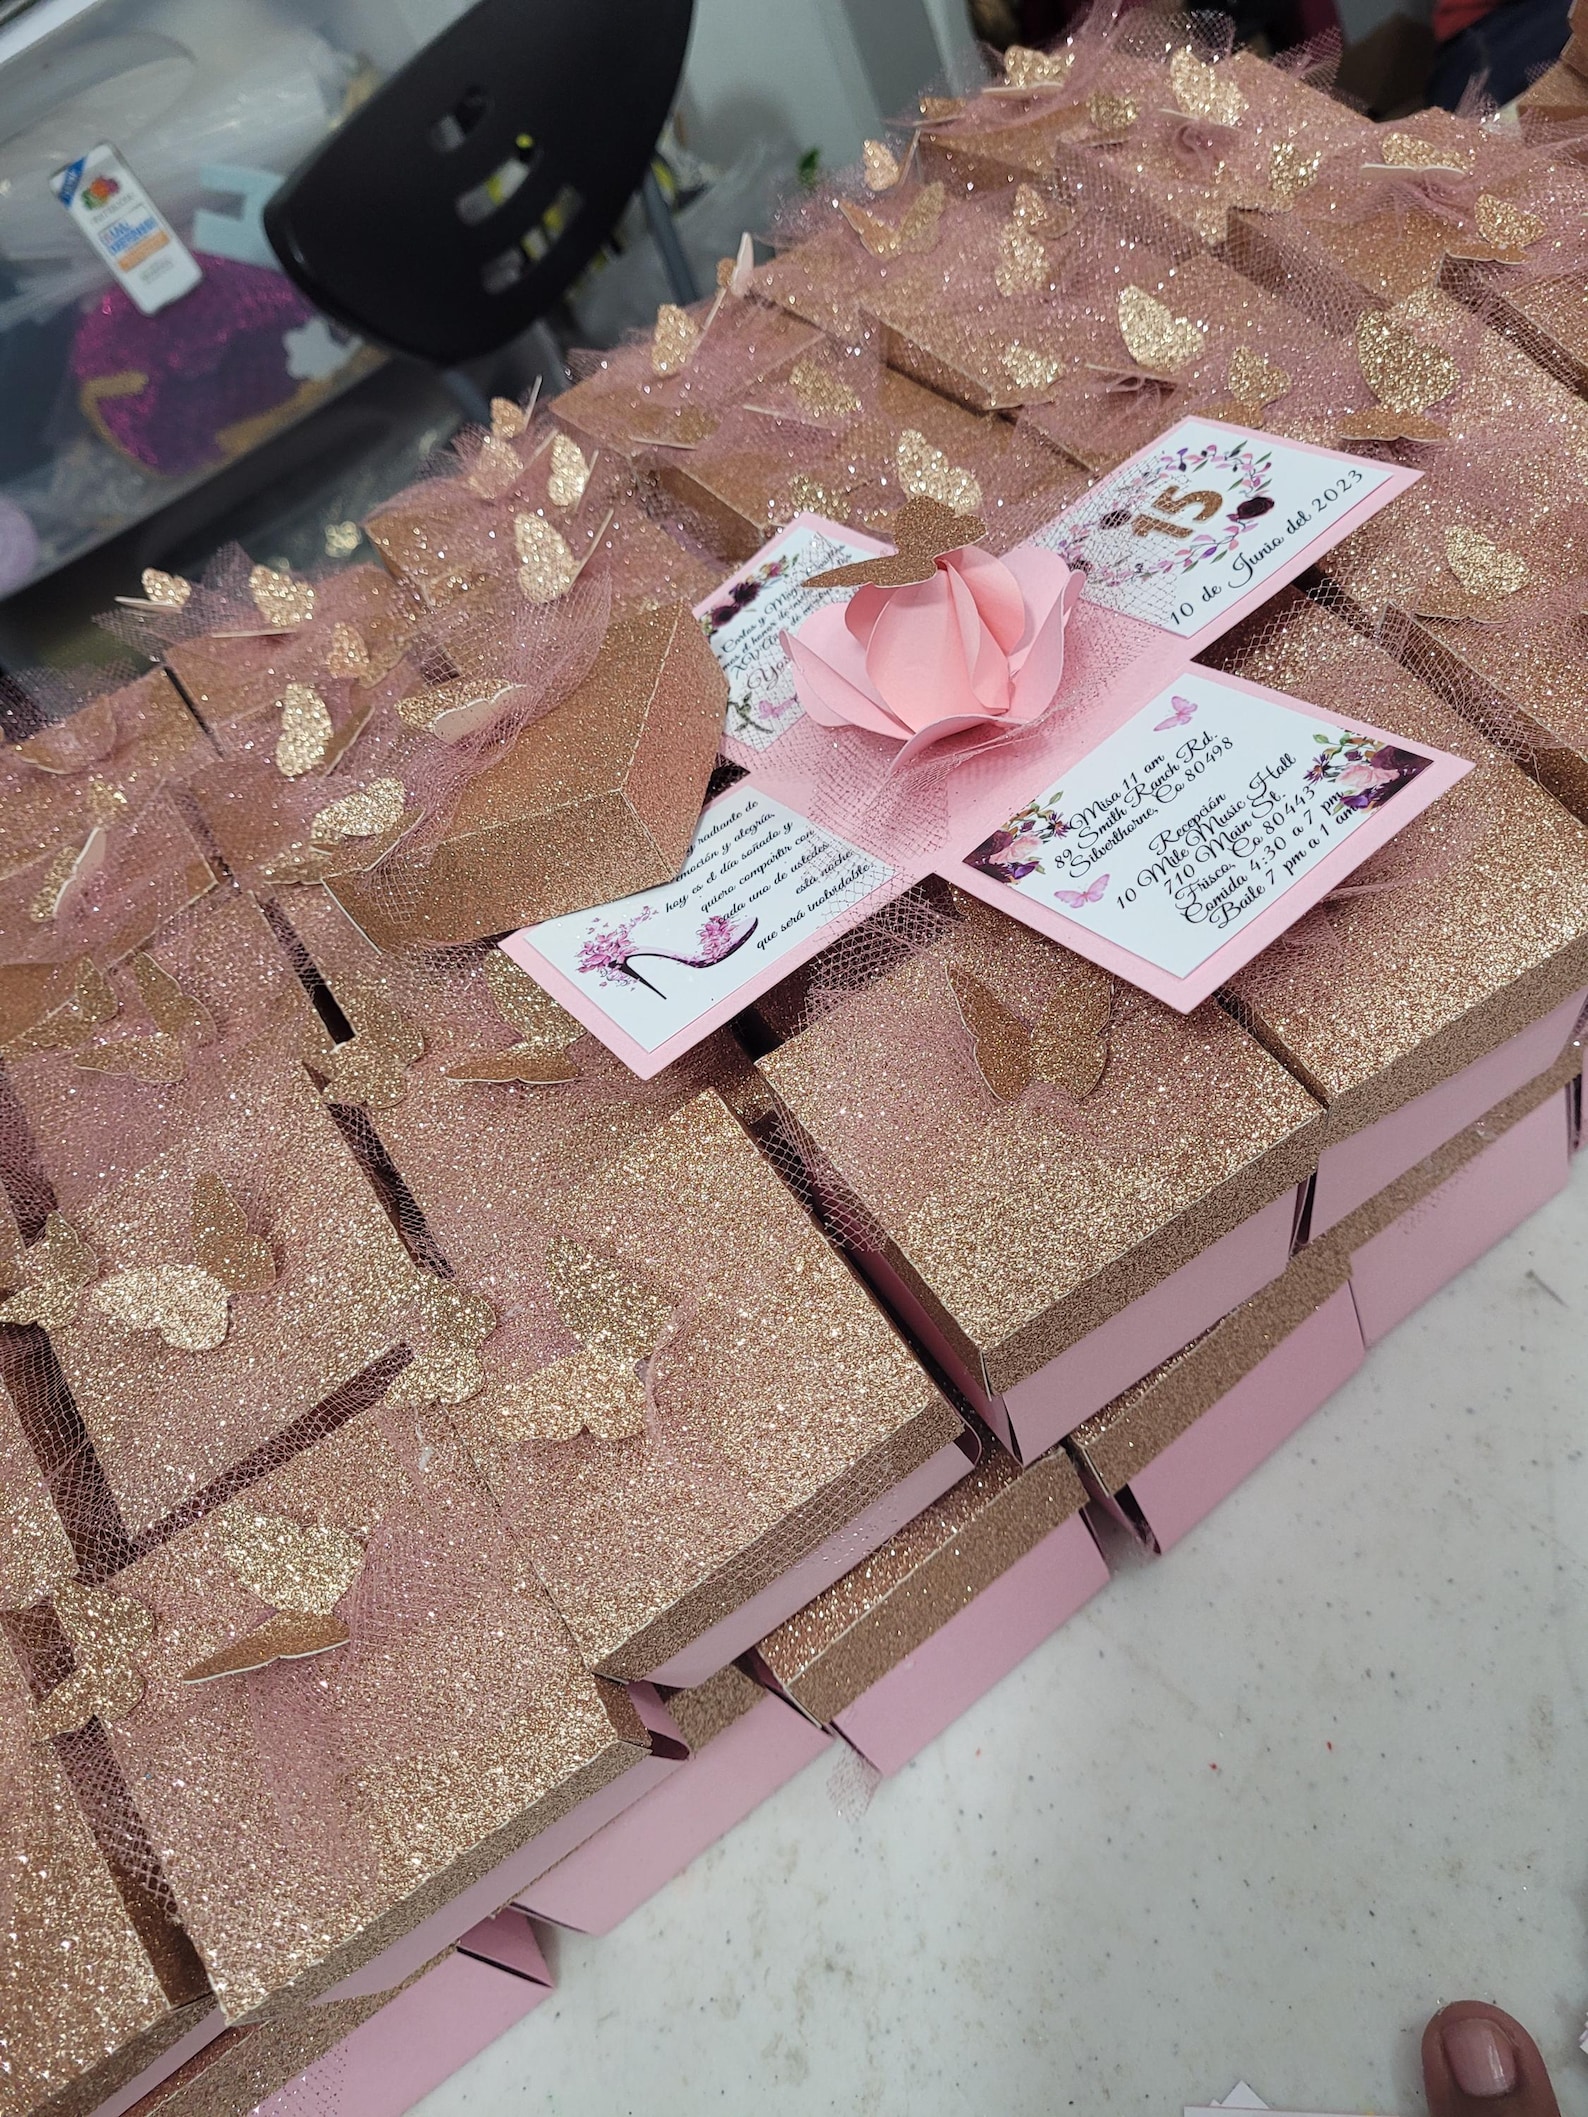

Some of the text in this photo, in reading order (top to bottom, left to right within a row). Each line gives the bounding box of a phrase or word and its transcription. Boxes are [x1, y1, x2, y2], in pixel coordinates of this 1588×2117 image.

[1131, 486, 1223, 539] 15
[1170, 469, 1363, 625] 10 de Junio del 2023
[751, 622, 777, 645] honor
[698, 800, 758, 844] radiante de
[1054, 731, 1218, 869] 89 Smith Ranch Rd.
[1069, 737, 1233, 878] Silverthorne, Co 80498
[1070, 754, 1165, 830] Misa 11 am
[1117, 753, 1296, 909] 10 Mile Music Hall
[1149, 793, 1226, 855] Recepción
[665, 822, 793, 912] hoy es el día soñado y
[675, 850, 719, 882] emoción
[721, 842, 731, 855] y
[701, 829, 815, 912] quiero compartir con
[719, 842, 830, 923] cada uno de ustedes
[1164, 791, 1286, 895] 710 Main St.
[1175, 785, 1315, 909] Frisco, Co 80443
[1180, 791, 1344, 923] Comida 4:30 a 7 pm
[1209, 804, 1358, 928] Baile 7 pm a 1 am
[757, 930, 778, 950] que
[781, 910, 805, 931] será
